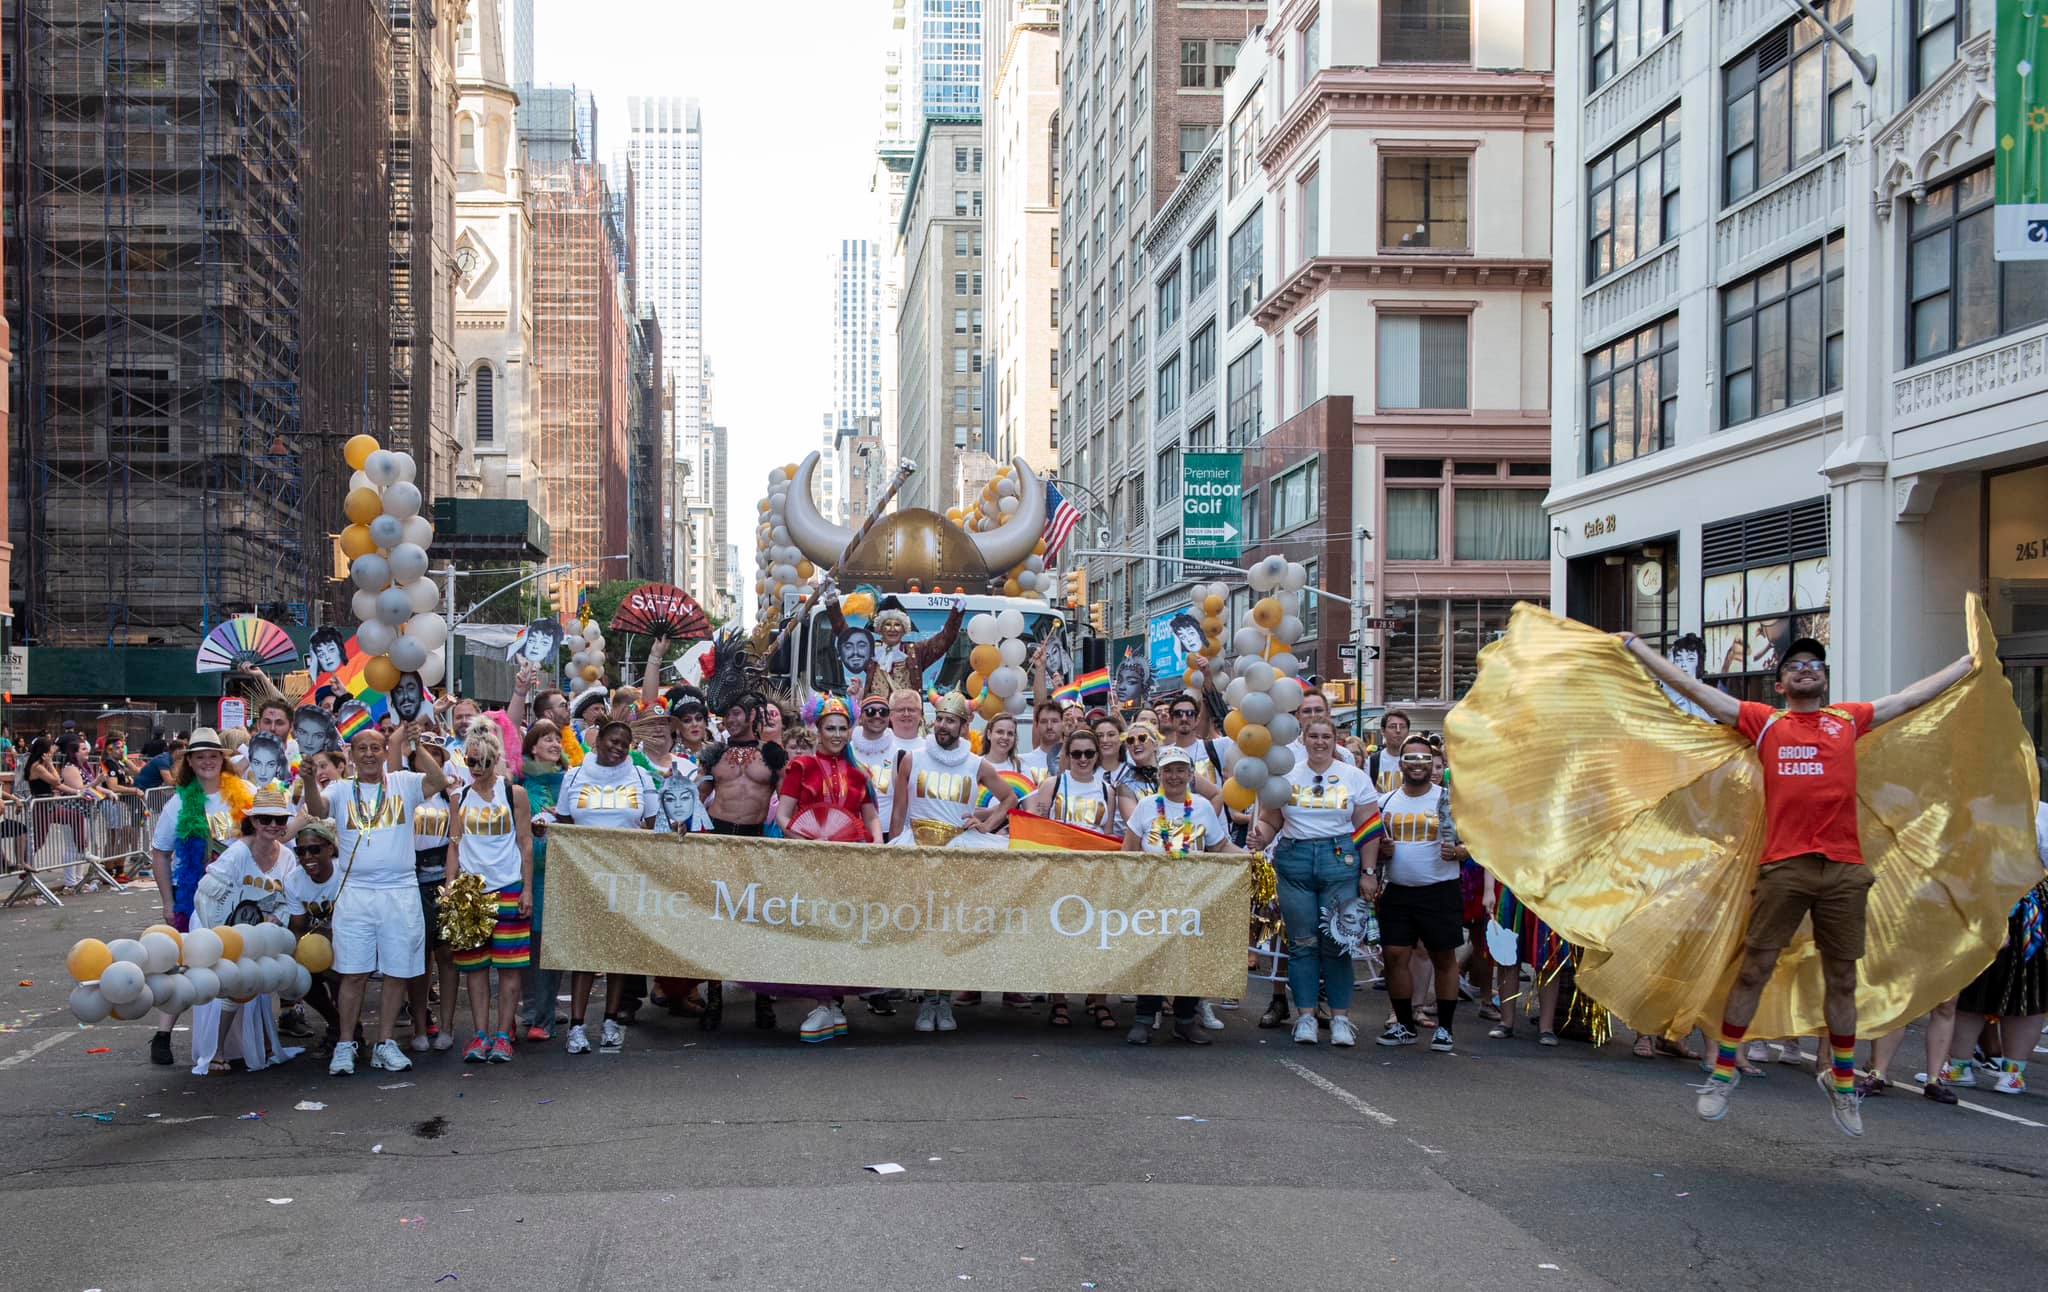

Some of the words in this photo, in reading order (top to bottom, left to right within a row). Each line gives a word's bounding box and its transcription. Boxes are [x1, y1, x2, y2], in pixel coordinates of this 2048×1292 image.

[1184, 467, 1231, 479] Premier
[1184, 481, 1242, 496] Indoor
[1184, 498, 1222, 514] Golf
[1605, 514, 1617, 534] 28
[1185, 537, 1196, 546] 35
[2015, 541, 2039, 562] 245
[631, 594, 693, 616] SATAN
[927, 596, 950, 607] 3479
[1373, 620, 1379, 628] E
[1379, 620, 1387, 628] 28
[1778, 745, 1818, 760] GROUP
[1778, 762, 1825, 776] LEADER
[591, 871, 689, 919] The
[708, 879, 1032, 945] Metropolitan
[1050, 894, 1205, 951] Opera
